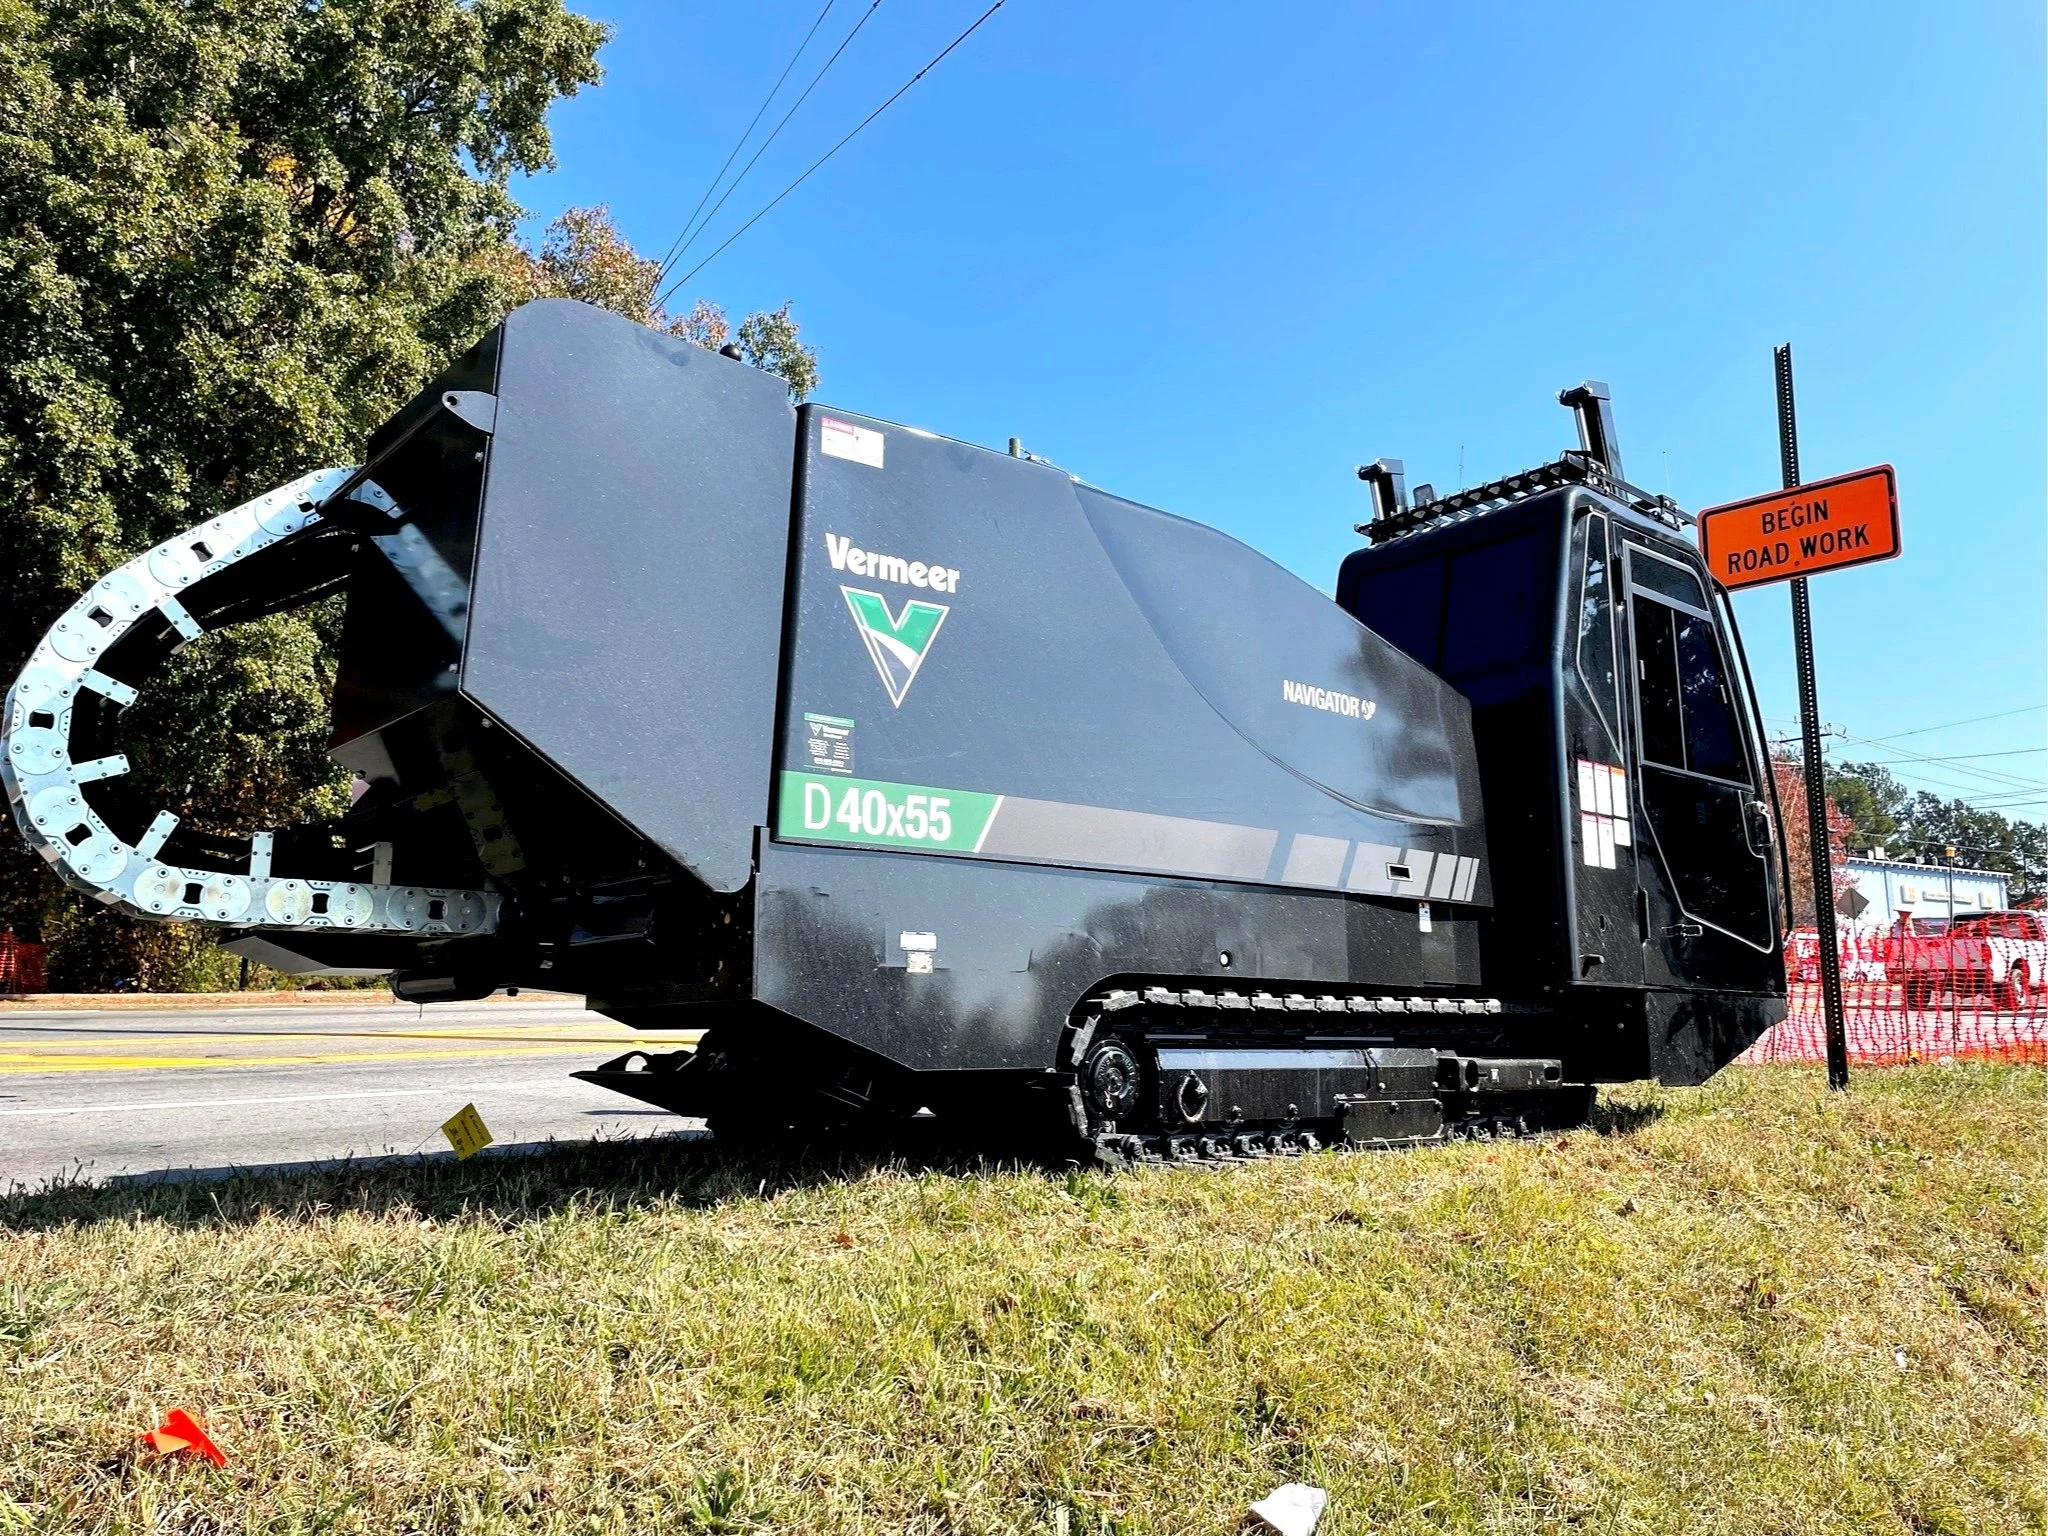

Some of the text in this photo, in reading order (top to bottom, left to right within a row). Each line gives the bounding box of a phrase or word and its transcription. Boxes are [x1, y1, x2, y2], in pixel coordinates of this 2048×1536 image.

[1762, 499, 1829, 534] BEGIN
[825, 532, 960, 593] Vermeer
[1728, 523, 1870, 575] ROAD WORK
[1283, 679, 1360, 718] NAVIGATOR
